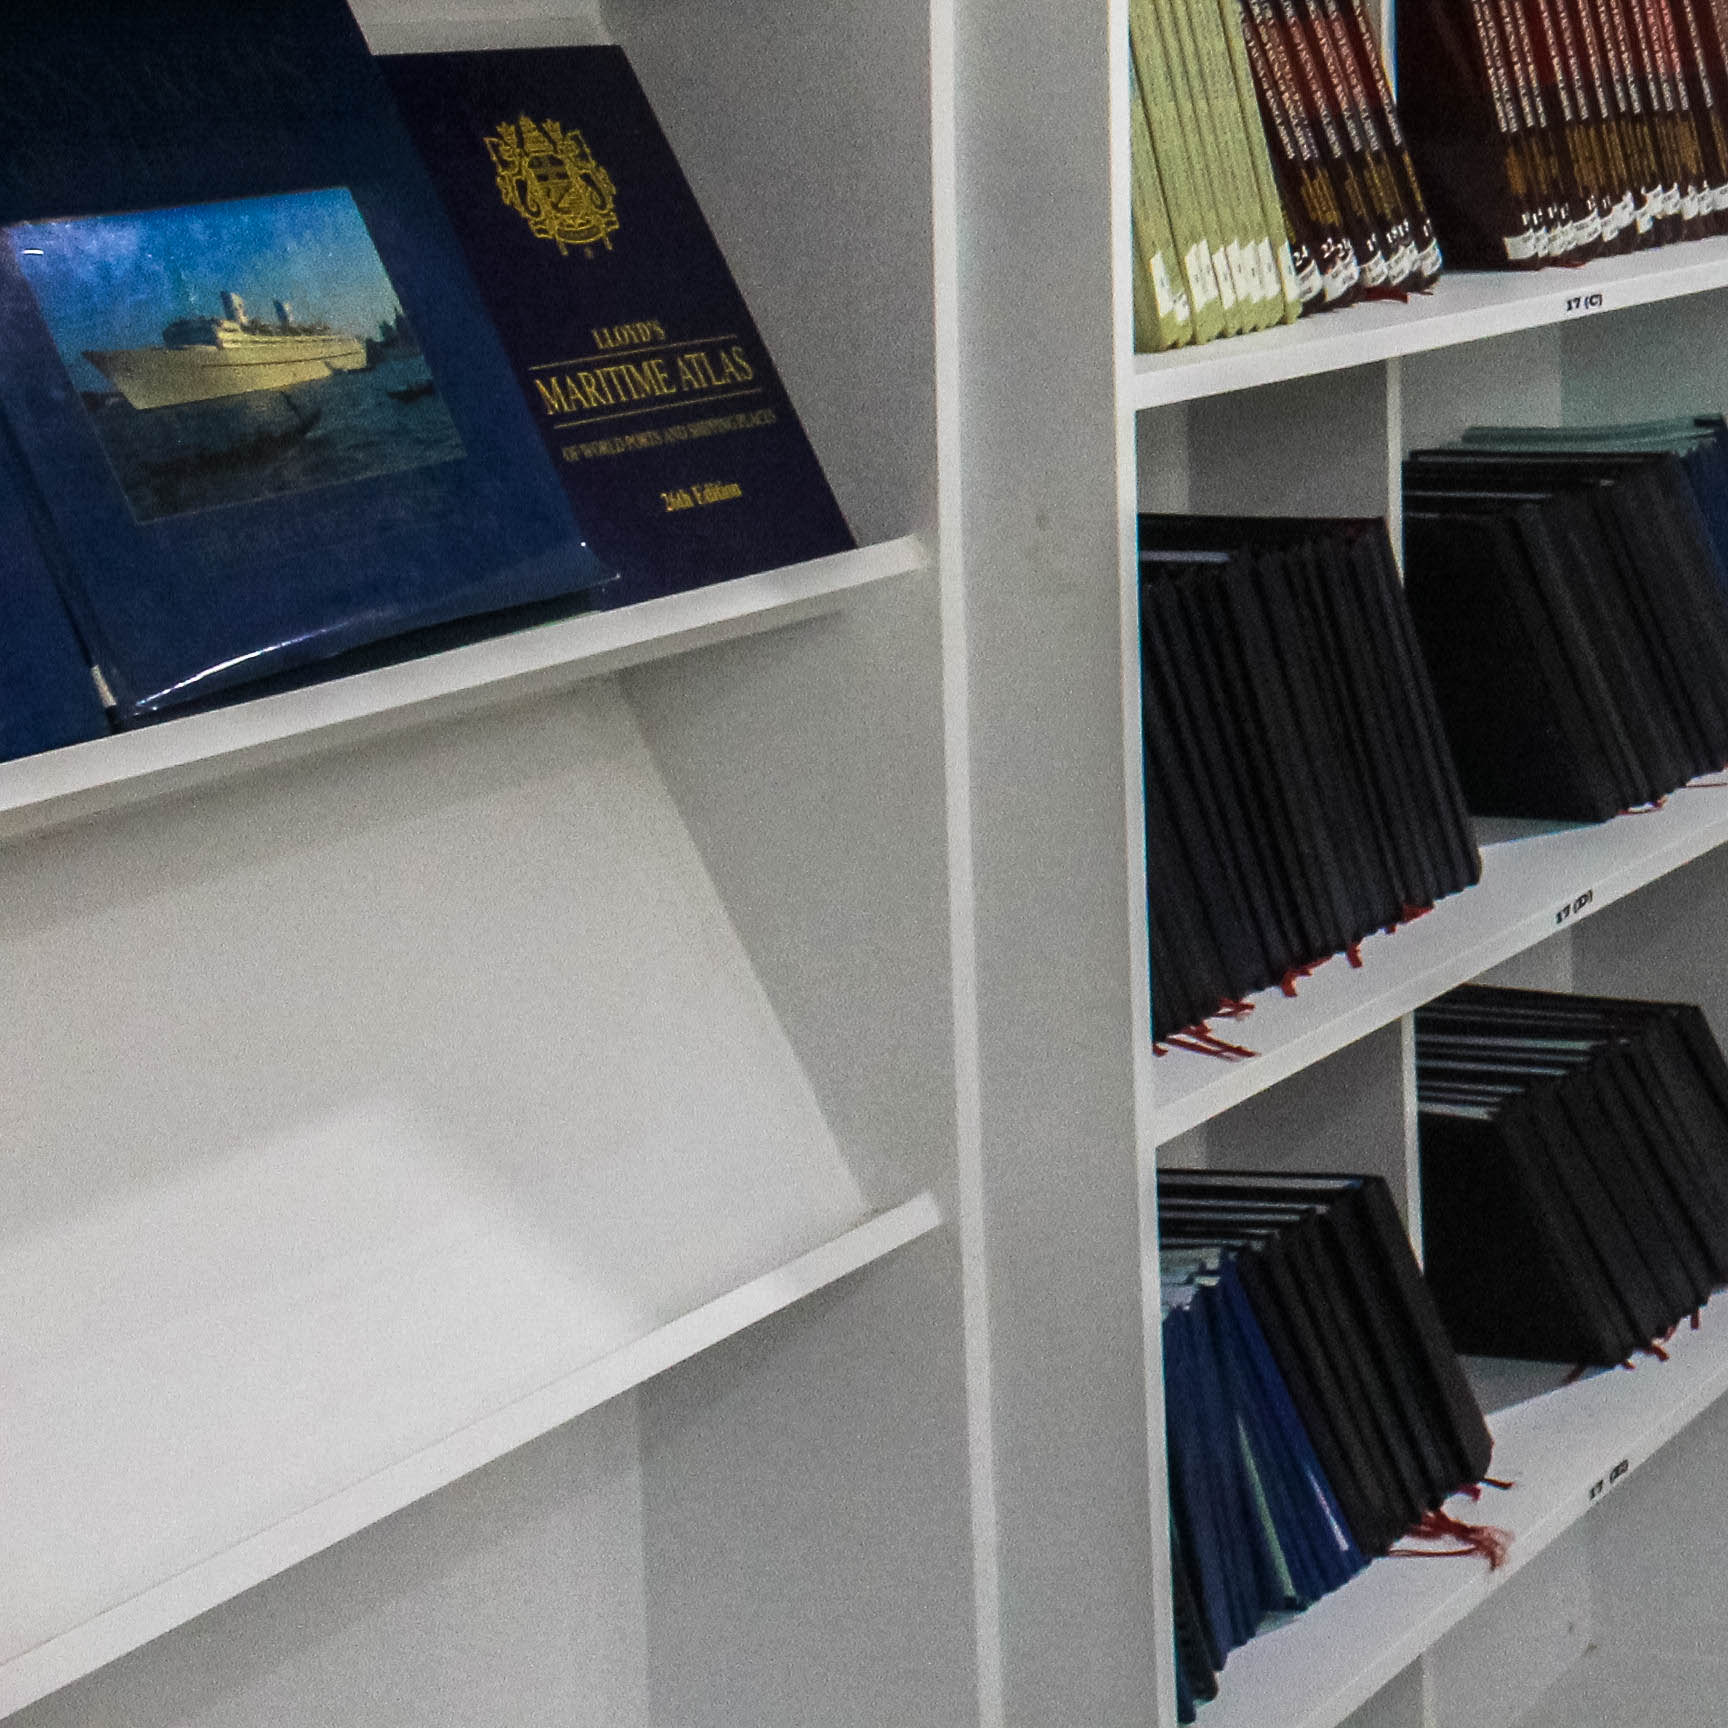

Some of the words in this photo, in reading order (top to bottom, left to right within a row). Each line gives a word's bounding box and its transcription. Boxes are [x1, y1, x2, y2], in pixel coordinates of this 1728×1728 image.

[592, 321, 665, 349] LLOYD'S
[536, 359, 676, 415] MARITIME
[677, 346, 754, 391] ATLAS
